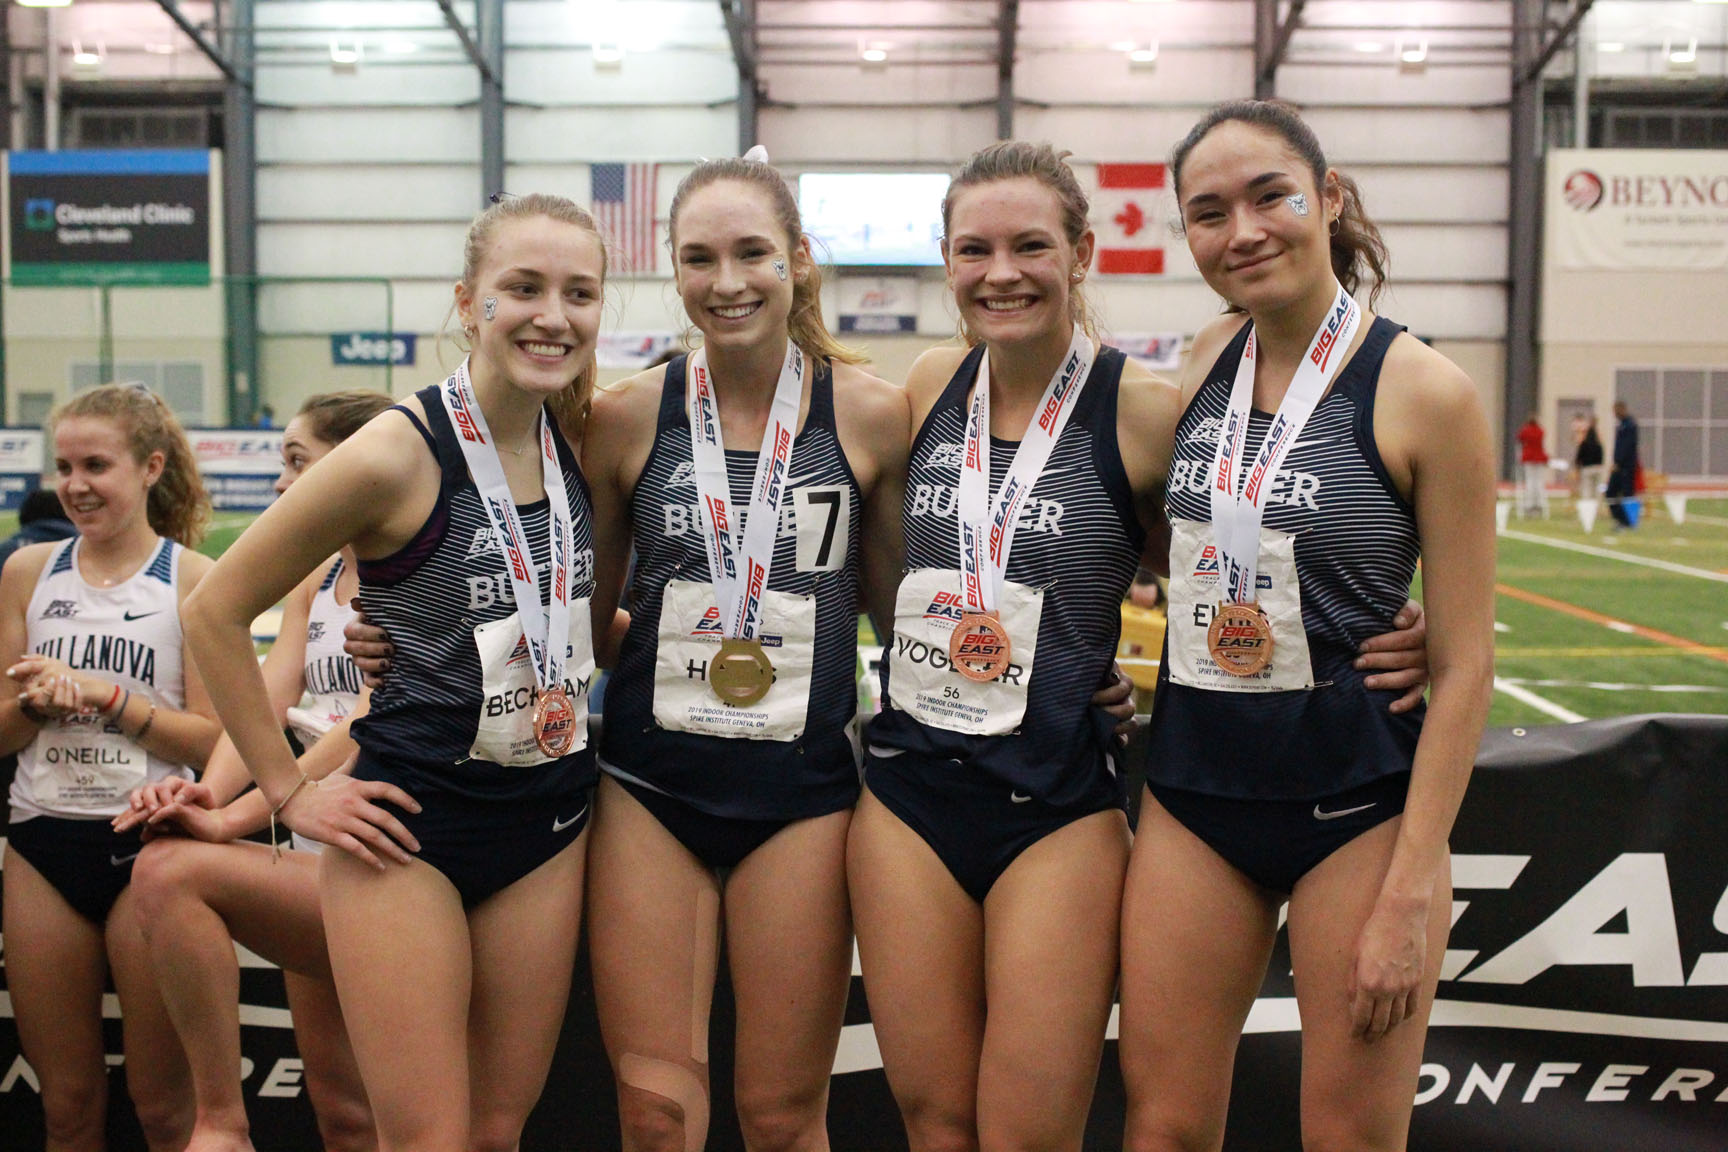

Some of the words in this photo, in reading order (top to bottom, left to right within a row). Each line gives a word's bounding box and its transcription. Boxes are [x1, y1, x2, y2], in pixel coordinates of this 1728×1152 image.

[55, 203, 142, 224] Cleveland
[144, 203, 195, 224] Clinic
[341, 335, 406, 361] Jeep
[808, 491, 840, 567] 7
[1222, 627, 1256, 637] BIG
[963, 634, 996, 645] BIG
[1218, 638, 1266, 647] EAST
[959, 644, 1005, 655] EAST
[486, 676, 591, 717] BECAM
[943, 686, 960, 699] 56
[547, 710, 568, 722] BIG
[725, 710, 769, 720] CHAMPIONSHIPS
[543, 719, 572, 732] EAST
[705, 717, 731, 726] INSTITUTE
[46, 747, 130, 765] O'NEILL
